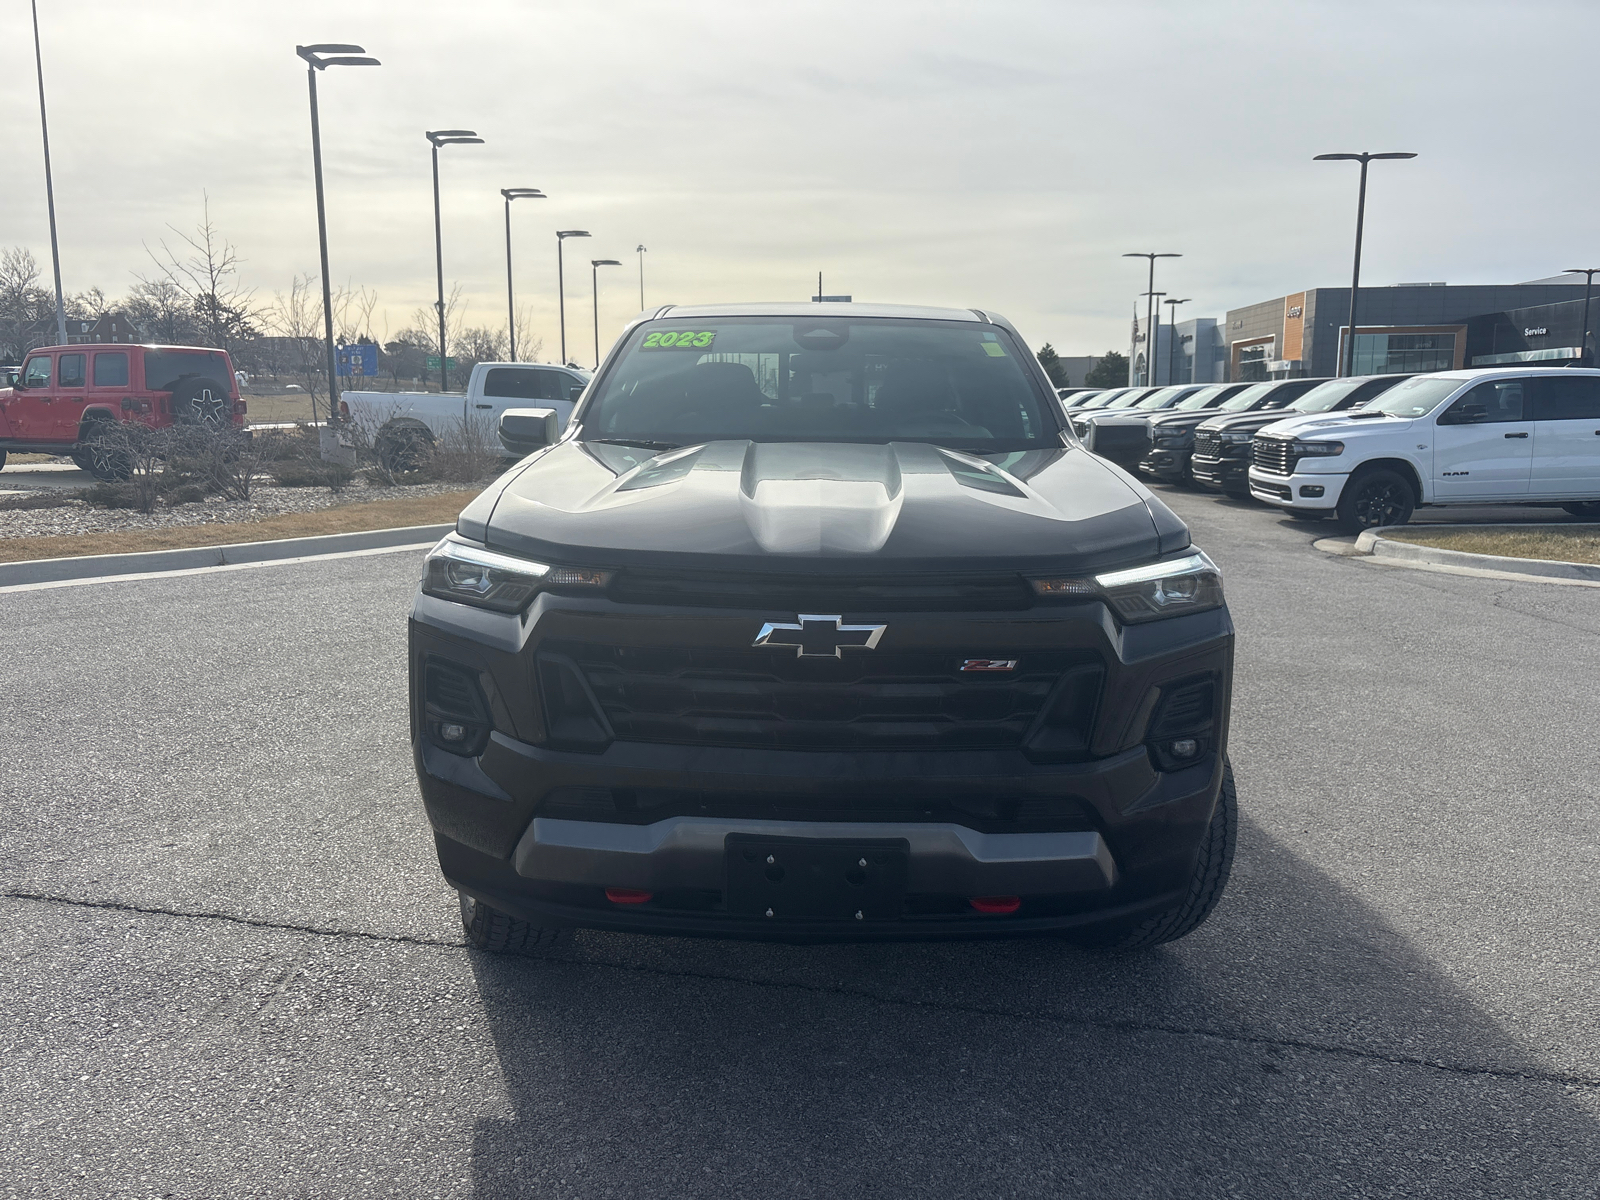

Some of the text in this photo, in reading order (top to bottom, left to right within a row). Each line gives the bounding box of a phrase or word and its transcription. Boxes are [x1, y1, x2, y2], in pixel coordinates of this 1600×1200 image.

[1524, 326, 1547, 337] Service
[643, 331, 716, 348] 2023
[960, 659, 1018, 670] Z71
